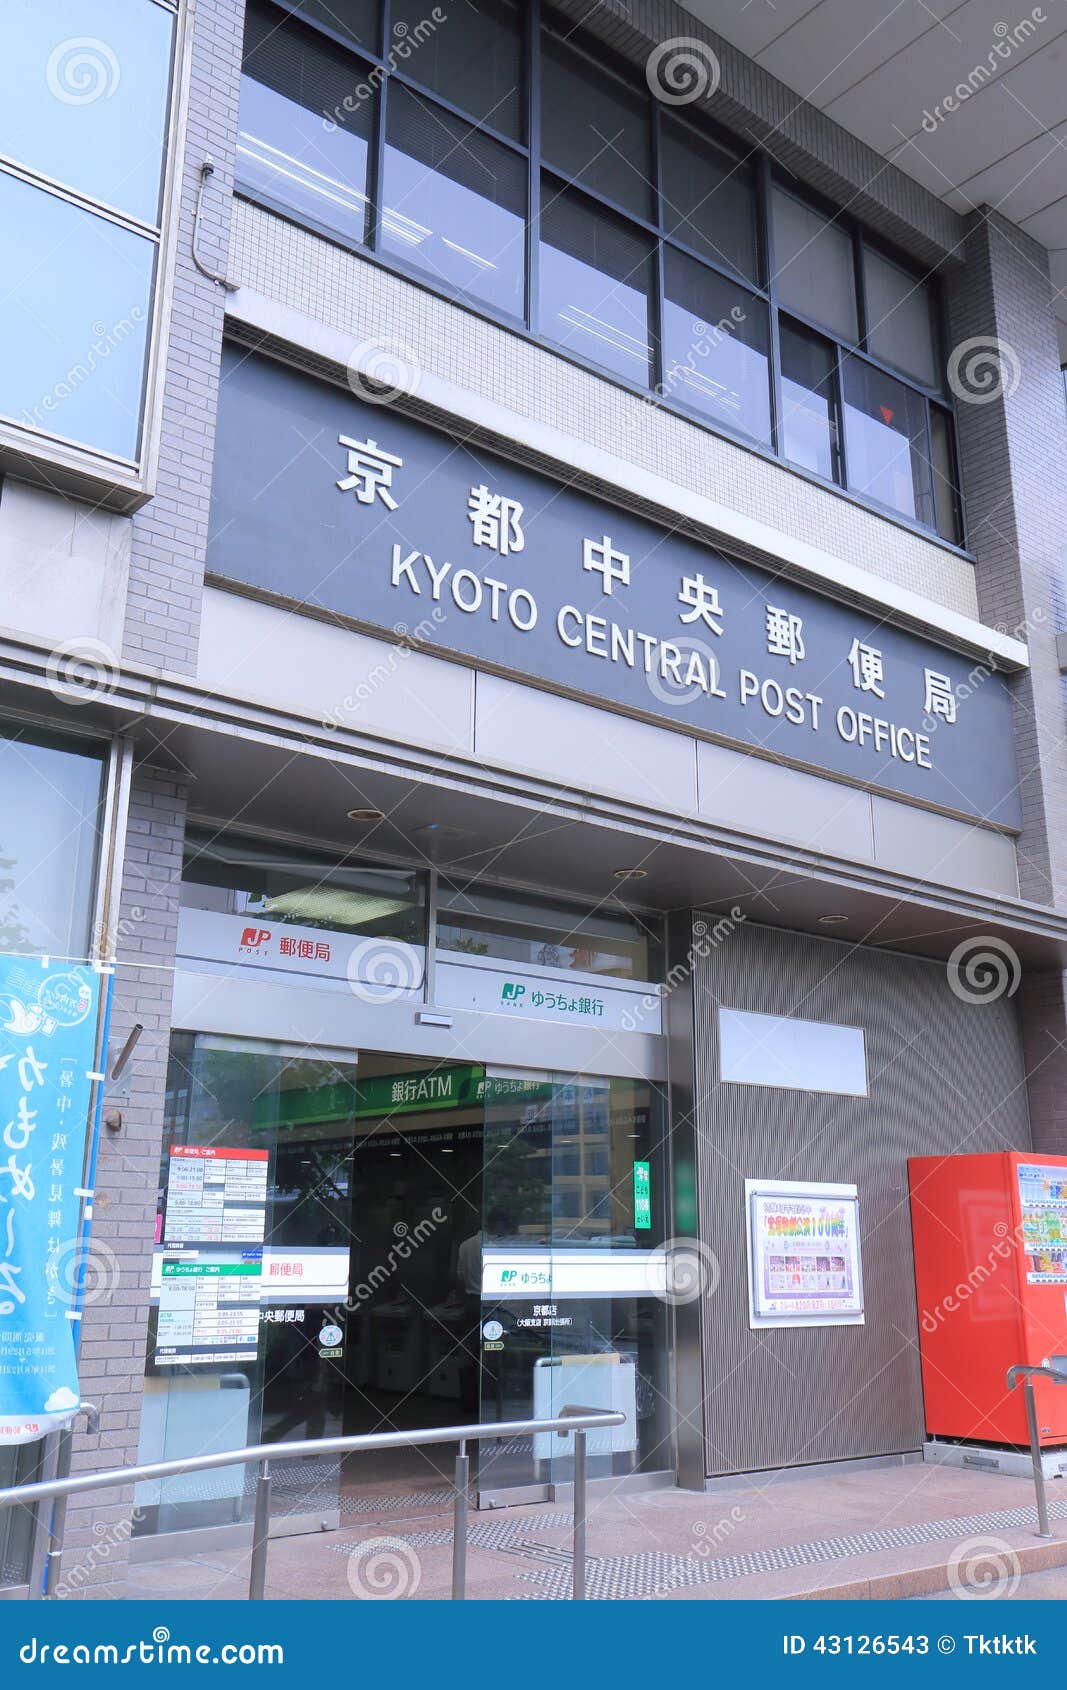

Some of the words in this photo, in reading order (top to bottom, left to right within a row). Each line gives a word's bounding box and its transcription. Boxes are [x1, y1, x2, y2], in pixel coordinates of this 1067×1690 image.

[336, 434, 956, 724] 京都中央郵便局
[391, 543, 539, 631] KYOTO
[556, 604, 727, 698] CENTRAL
[739, 669, 824, 730] POST
[836, 705, 933, 770] OFFICE
[241, 928, 271, 946] JP
[280, 937, 330, 961] 郵便局
[502, 983, 526, 1000] JP
[531, 991, 604, 1016] ゆうちょ銀行
[391, 1075, 451, 1102] 銀行ATM
[494, 1080, 540, 1094] ゆうちょ銀行
[269, 1262, 304, 1277] 郵便局
[533, 1304, 557, 1316] 京都店
